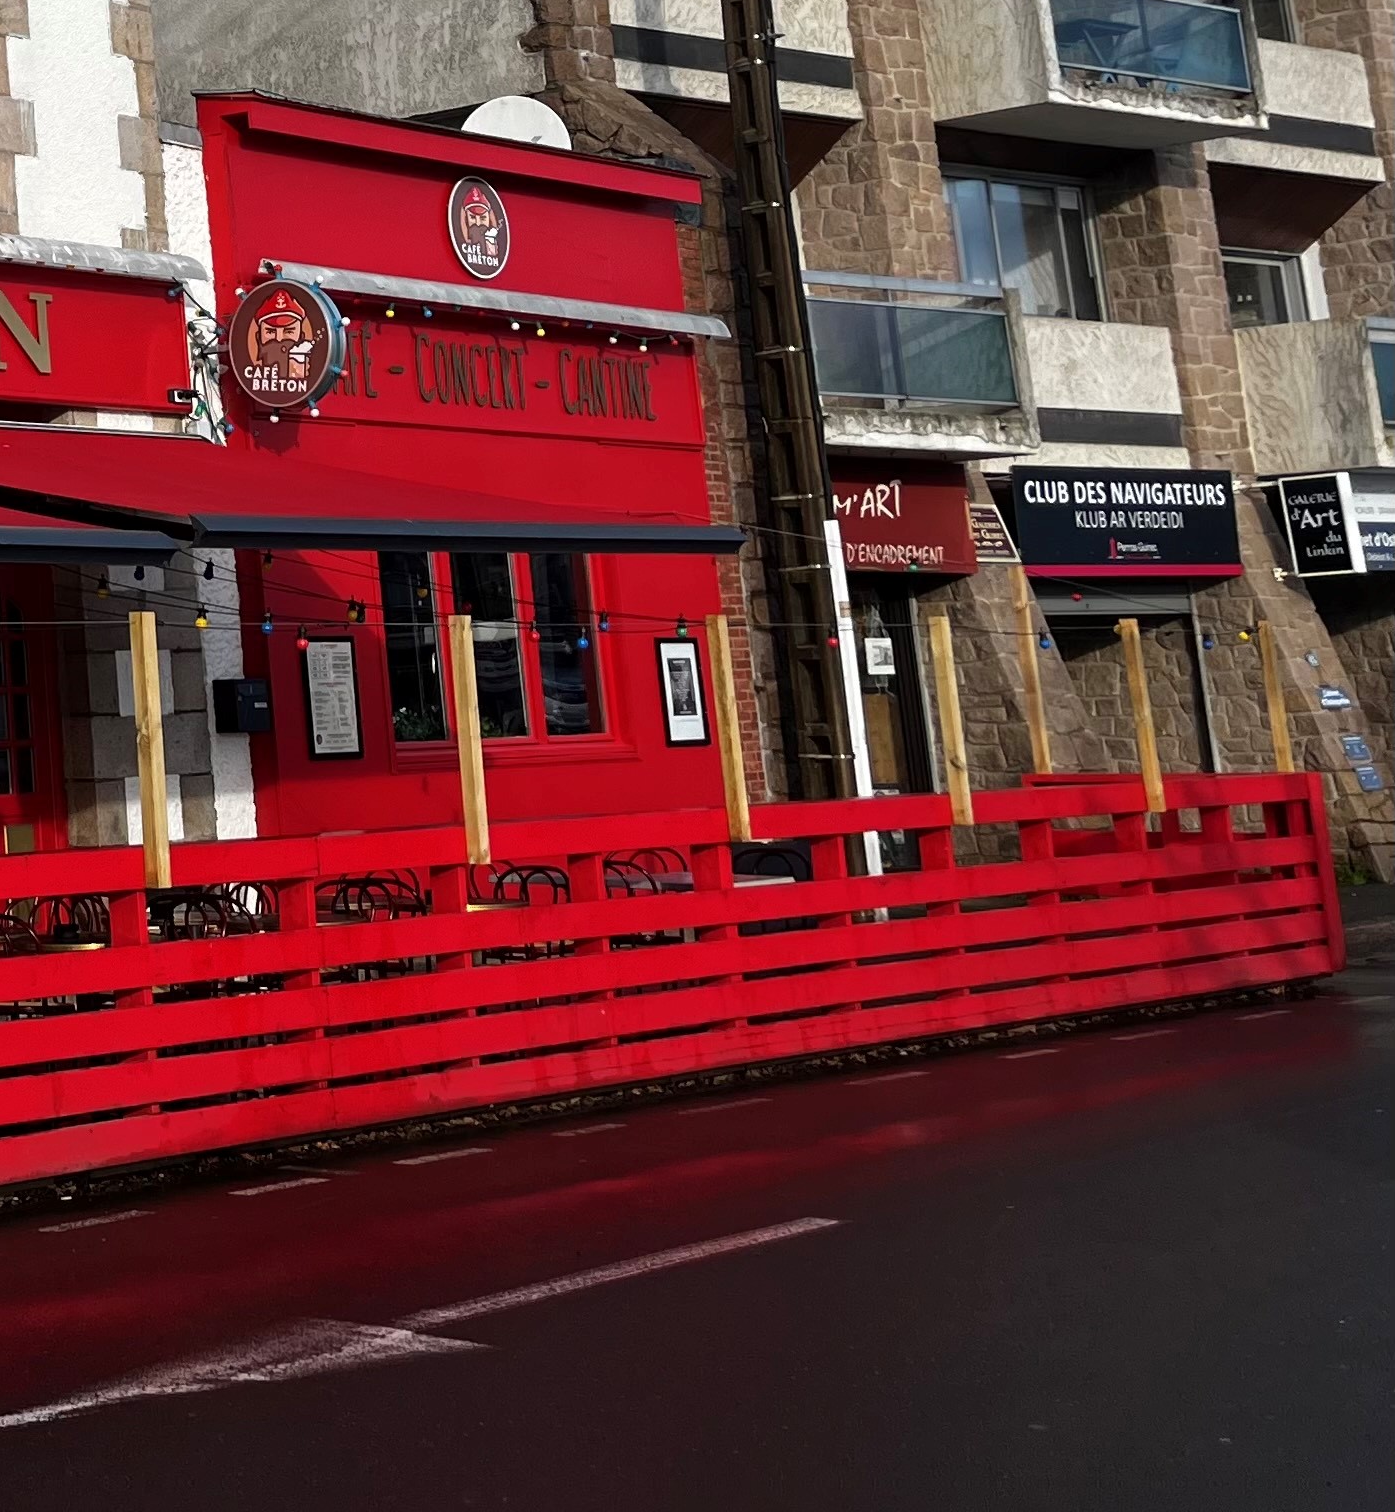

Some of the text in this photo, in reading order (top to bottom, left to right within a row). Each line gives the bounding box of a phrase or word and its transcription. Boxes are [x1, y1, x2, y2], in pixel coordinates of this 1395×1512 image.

[462, 242, 482, 255] CAFÉ
[467, 253, 499, 266] BRETON
[244, 363, 279, 379] CAFÉ
[332, 320, 377, 398] FÉ
[559, 348, 657, 421] CANTINE
[252, 378, 308, 393] BRETON
[1024, 480, 1226, 506] CLUB DES NAVIGATEURS
[1075, 510, 1184, 529] KLUB AR VERDEIDI
[1326, 530, 1342, 543] du
